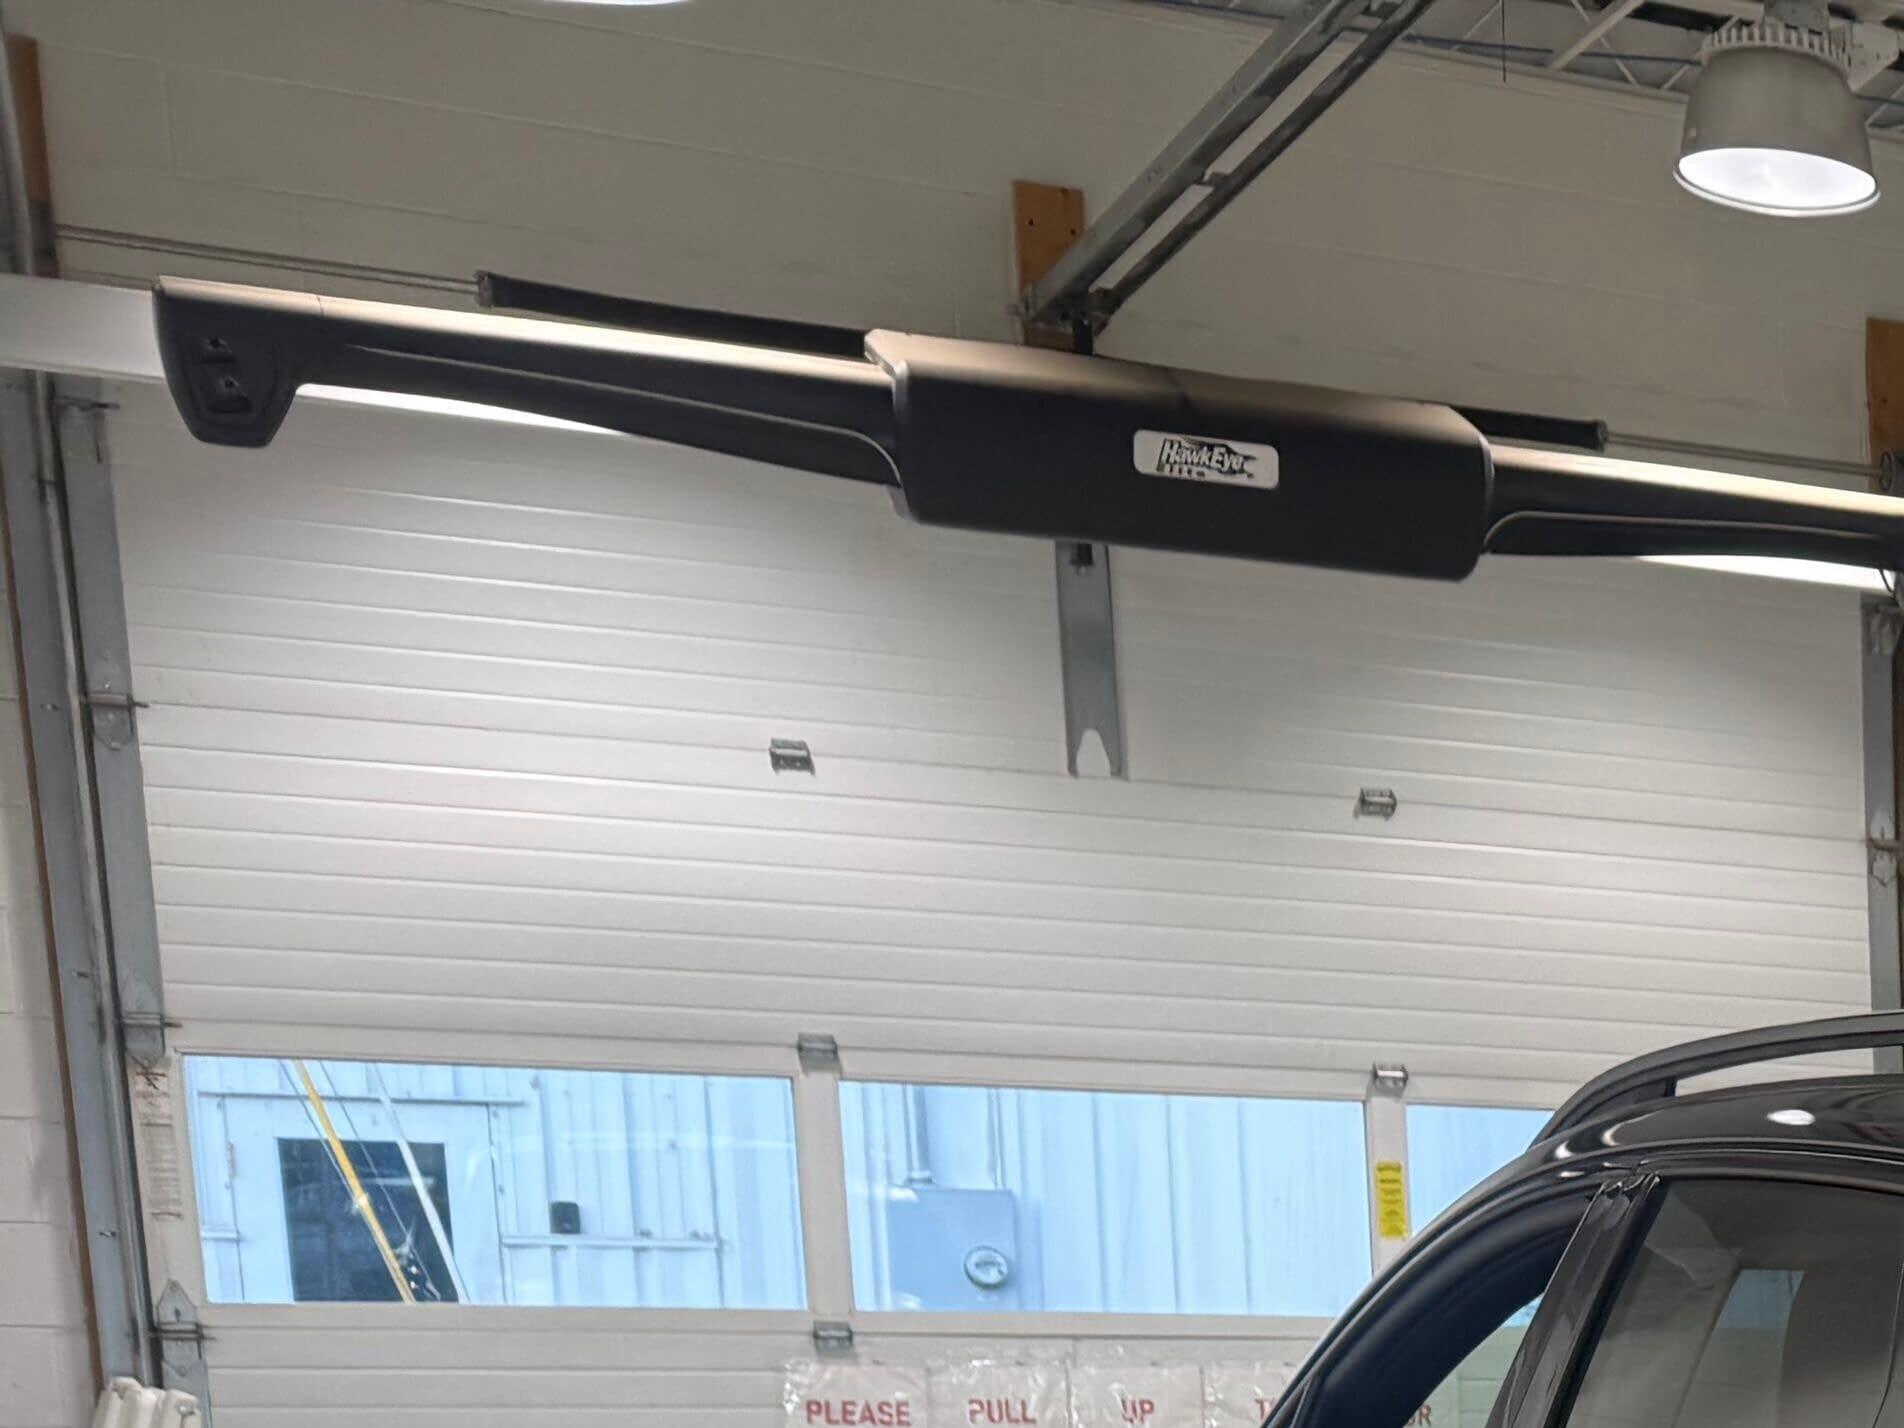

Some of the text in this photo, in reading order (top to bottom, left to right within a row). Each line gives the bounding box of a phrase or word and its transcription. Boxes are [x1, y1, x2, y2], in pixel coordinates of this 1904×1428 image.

[805, 1399, 911, 1428] PLEASE
[968, 1399, 1037, 1425] PULL
[1121, 1398, 1155, 1424] UP
